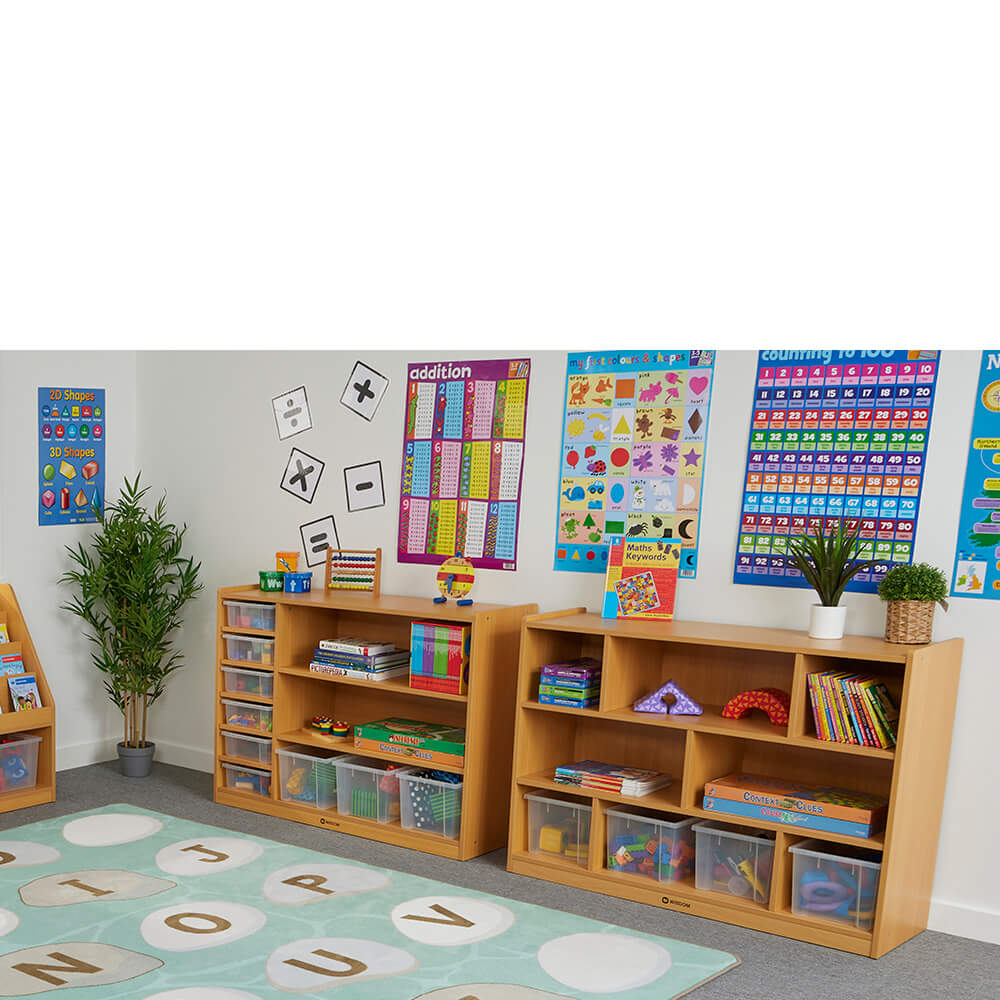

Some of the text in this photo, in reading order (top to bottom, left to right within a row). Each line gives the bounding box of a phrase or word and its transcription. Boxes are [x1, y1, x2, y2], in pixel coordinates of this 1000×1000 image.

[569, 352, 686, 370] my first colours & shapes
[410, 362, 472, 380] addition
[885, 366, 892, 374] 8
[921, 365, 931, 373] 10
[411, 381, 506, 394] 1 2 3 4
[899, 388, 909, 396] 19
[916, 388, 930, 396] 20
[49, 390, 96, 403] 2D Shapes
[840, 411, 852, 419] 26
[858, 411, 870, 419] 27
[876, 411, 889, 419] 28
[913, 411, 927, 419] 30
[821, 433, 832, 441] 35
[838, 433, 849, 441] 36
[856, 433, 867, 441] 37
[874, 433, 886, 441] 38
[892, 433, 904, 441] 39
[49, 447, 96, 460] 3D Shapes
[406, 442, 501, 454] 5 6 7 8
[402, 499, 498, 514] 9 10 11 12
[627, 543, 653, 552] Maths
[626, 552, 667, 562] Keywords
[183, 844, 230, 863] J
[58, 879, 113, 897] I
[281, 874, 334, 895] P
[401, 903, 475, 928] V
[164, 912, 232, 934] O
[10, 951, 104, 987] N
[284, 949, 368, 978] U
